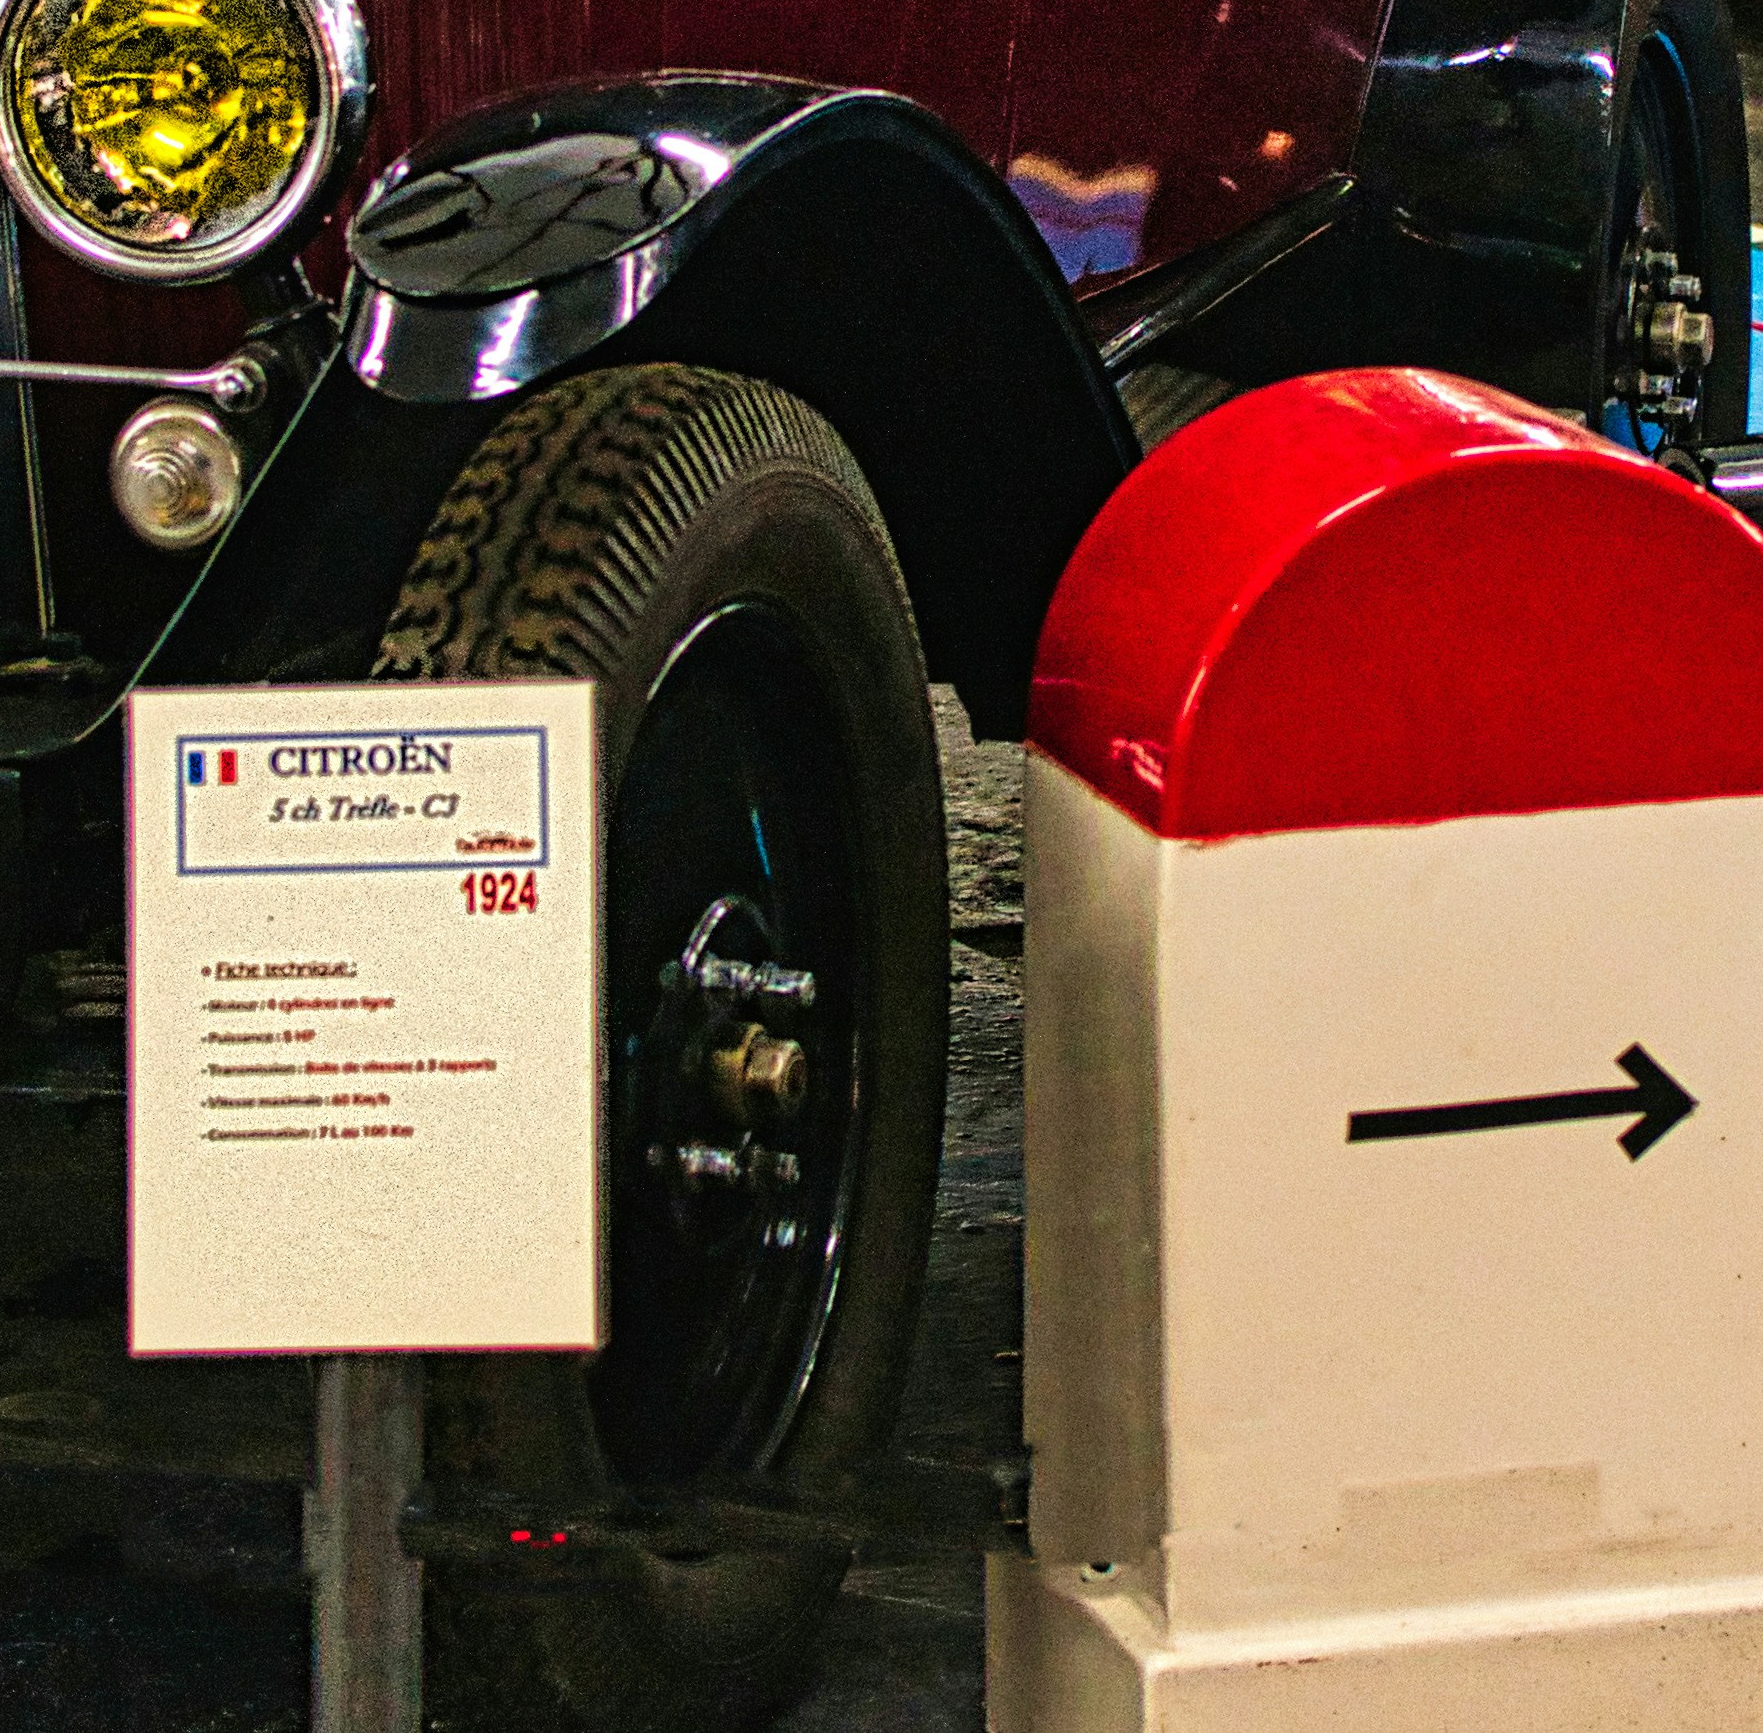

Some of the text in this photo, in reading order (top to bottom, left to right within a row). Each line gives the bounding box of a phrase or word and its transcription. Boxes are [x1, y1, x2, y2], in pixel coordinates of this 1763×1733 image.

[268, 735, 453, 777] CITROËN
[268, 797, 290, 822] 5
[291, 797, 321, 821] ch
[460, 869, 539, 915] 1924
[215, 961, 260, 980] Fiche
